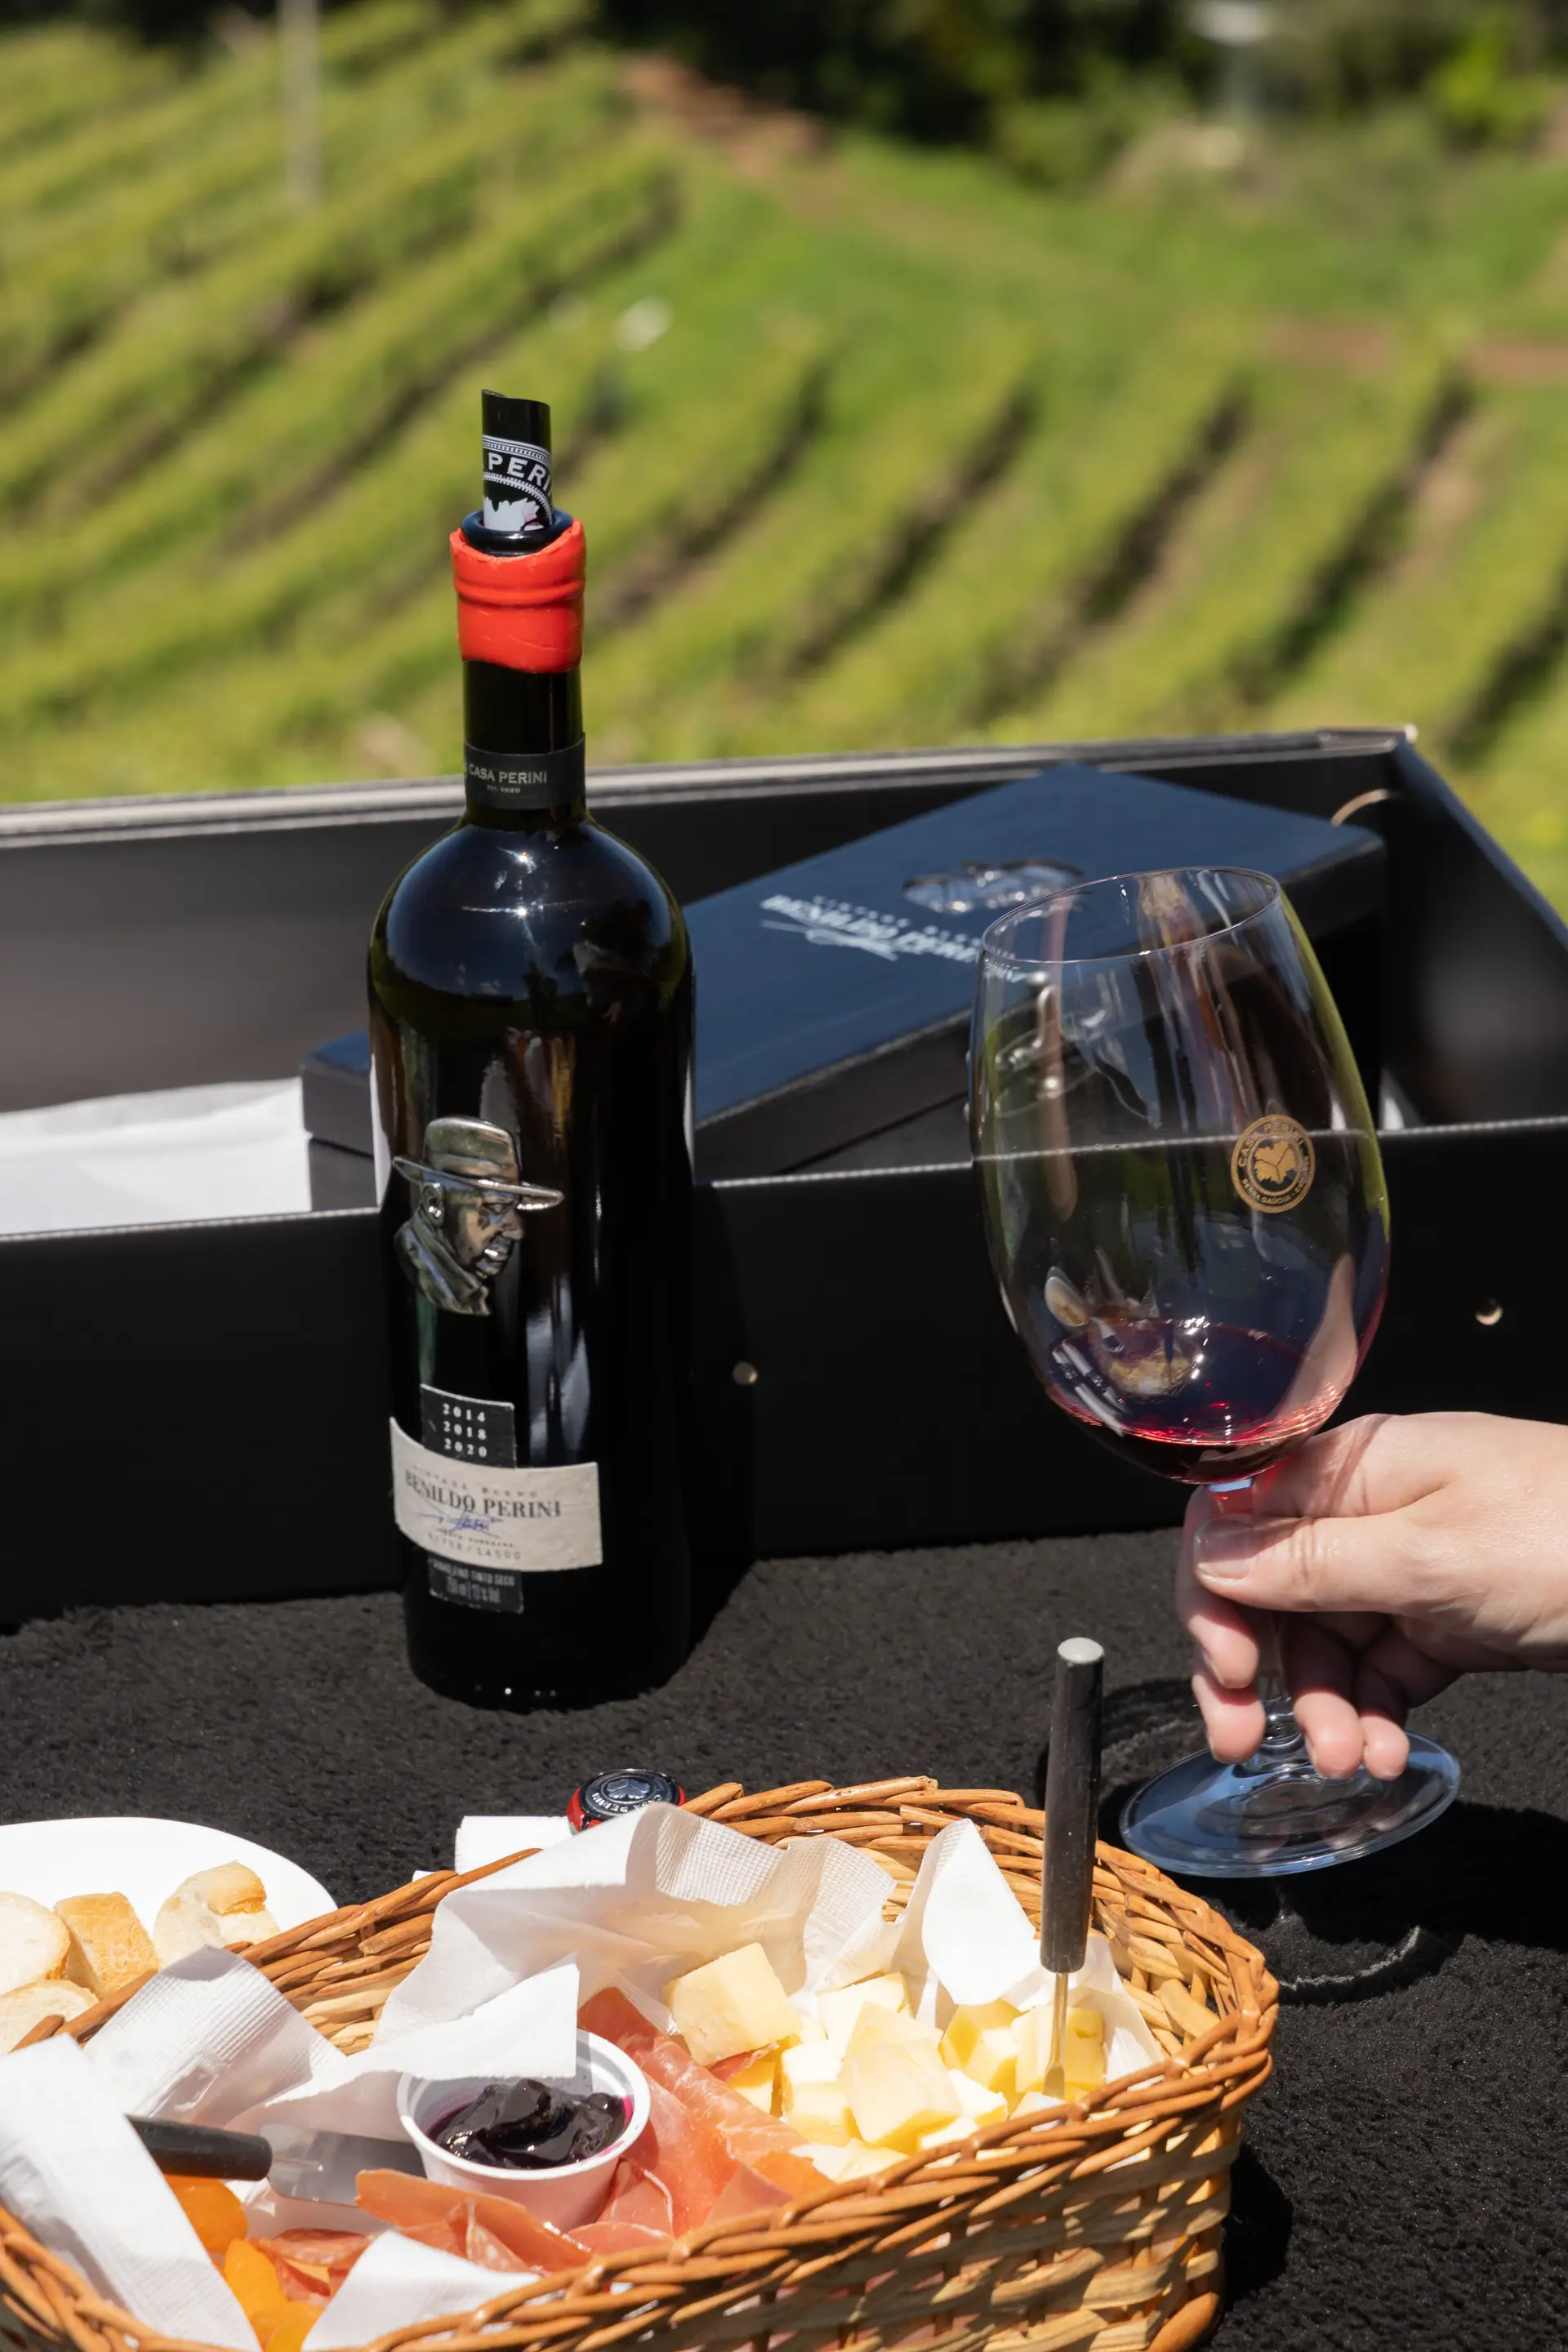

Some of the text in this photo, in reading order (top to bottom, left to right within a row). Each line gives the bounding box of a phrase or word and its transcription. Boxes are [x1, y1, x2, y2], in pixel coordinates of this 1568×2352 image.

[488, 452, 553, 496] PERI
[469, 763, 547, 784] CASA PERINI
[1238, 1123, 1305, 1167] CASA PERINI
[443, 1403, 486, 1423] 2014
[443, 1421, 487, 1441] 2018
[444, 1438, 488, 1458] 2020
[405, 1468, 562, 1518] BENILDO PERINI
[591, 1793, 629, 1812] PERINI
